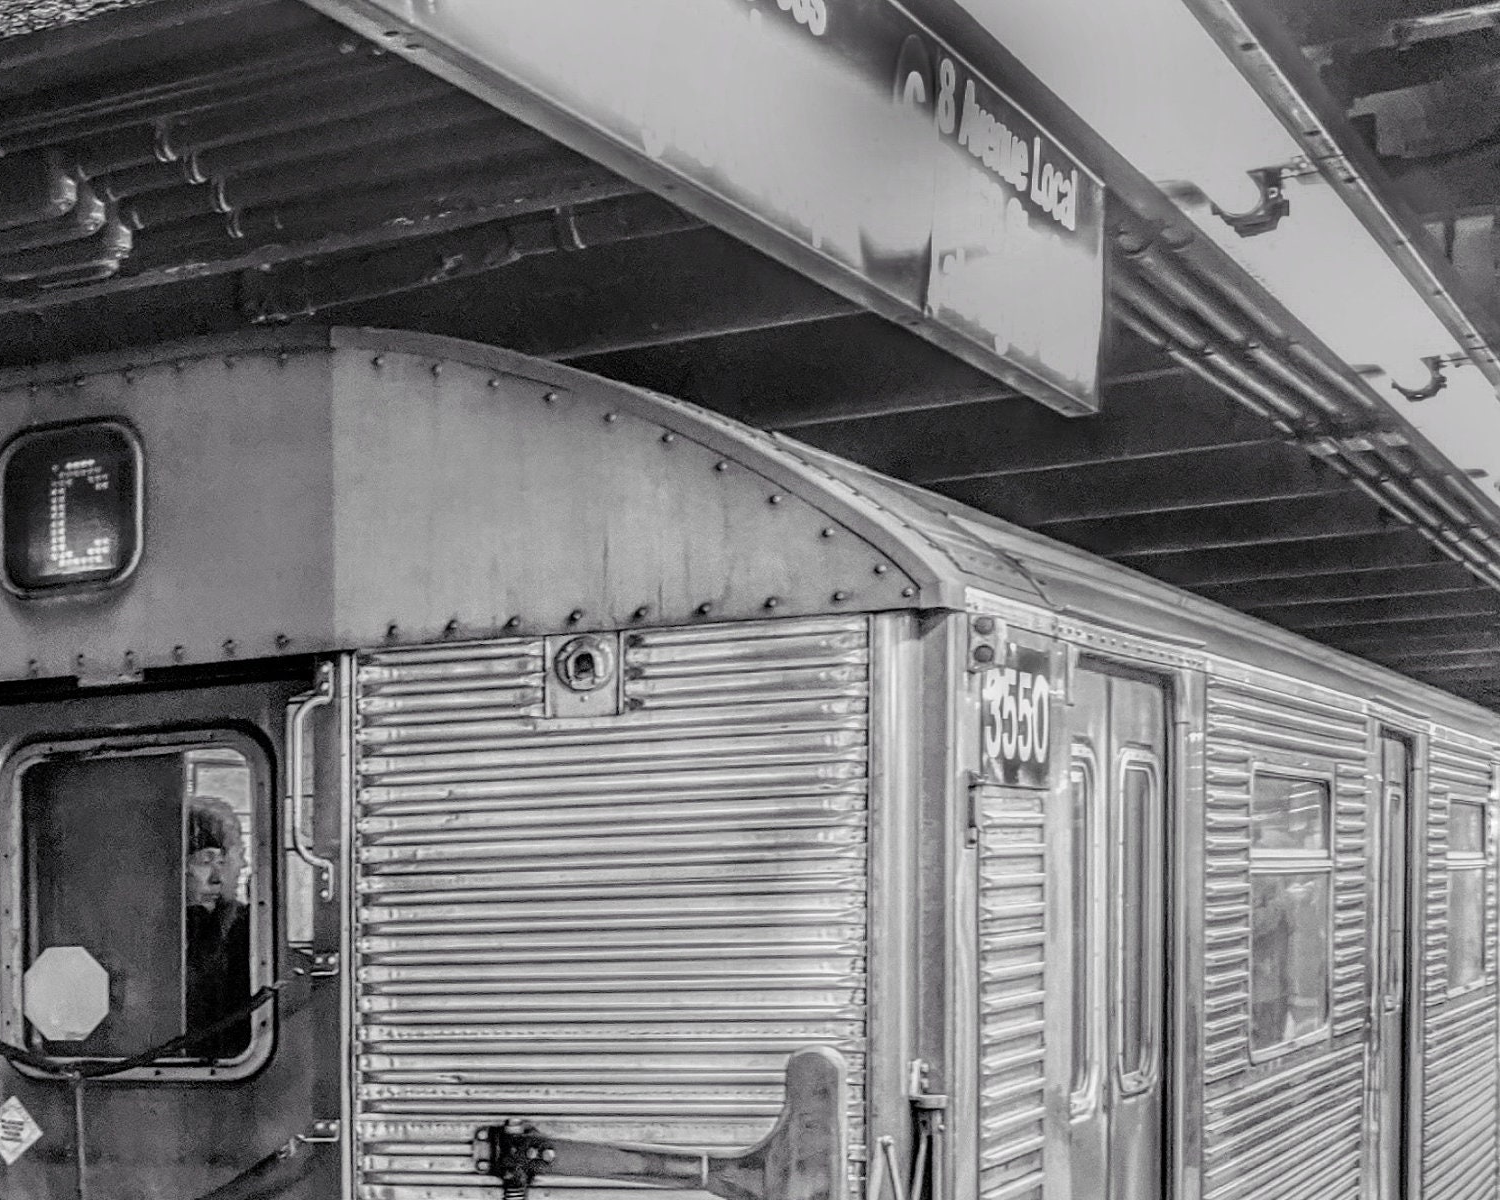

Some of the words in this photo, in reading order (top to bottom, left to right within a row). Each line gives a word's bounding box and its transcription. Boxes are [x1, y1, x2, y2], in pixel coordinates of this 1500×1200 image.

[938, 58, 956, 134] 8
[958, 79, 1029, 192] Avenue
[1031, 136, 1078, 231] Local
[51, 458, 110, 568] C
[982, 667, 1049, 764] 3550
